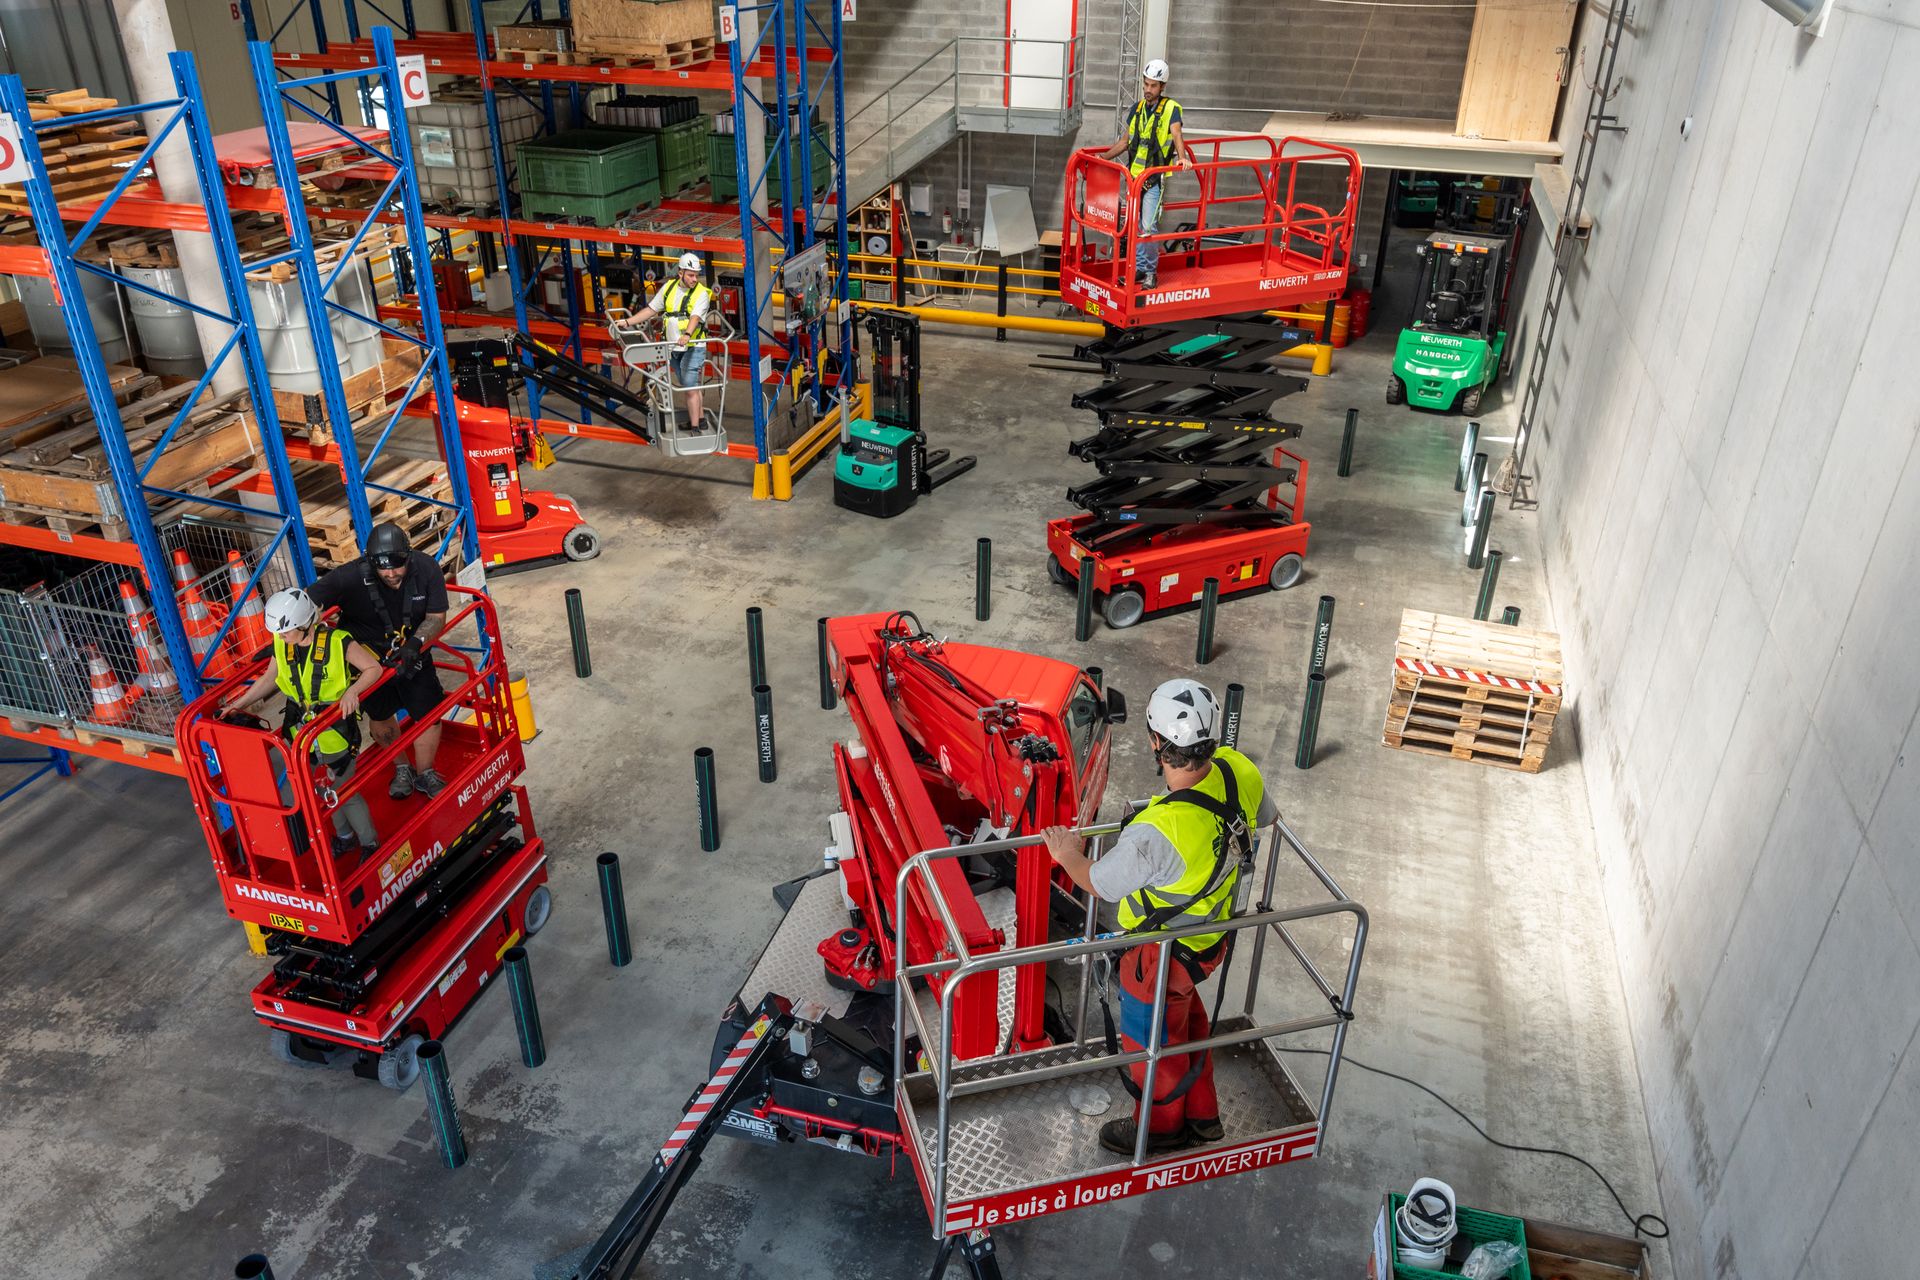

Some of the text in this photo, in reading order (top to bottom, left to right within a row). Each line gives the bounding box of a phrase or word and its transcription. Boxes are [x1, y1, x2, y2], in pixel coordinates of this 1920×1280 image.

[843, 0, 853, 15] A
[723, 16, 732, 35] B
[404, 70, 424, 100] C
[1087, 205, 1115, 222] NEUWERTH
[1259, 275, 1308, 290] NEUWERTH
[1326, 270, 1342, 279] XEN
[1075, 277, 1111, 300] HANGCHA
[1146, 287, 1210, 305] HANGCHA
[1420, 334, 1462, 348] NEUWERTH
[1416, 349, 1460, 361] HANGCHA
[468, 446, 514, 458] NEUWERTH
[861, 441, 893, 455] NEUWERTH
[1314, 622, 1329, 667] NEUWERTH
[759, 714, 772, 763] NEUWERTH
[457, 749, 510, 808] NEUWERTH
[367, 840, 444, 922] HANGCHA
[234, 883, 330, 915] HANGCHA
[271, 914, 303, 931] IPAF
[975, 1144, 1285, 1227] Je suis à louer NEUWERTH
